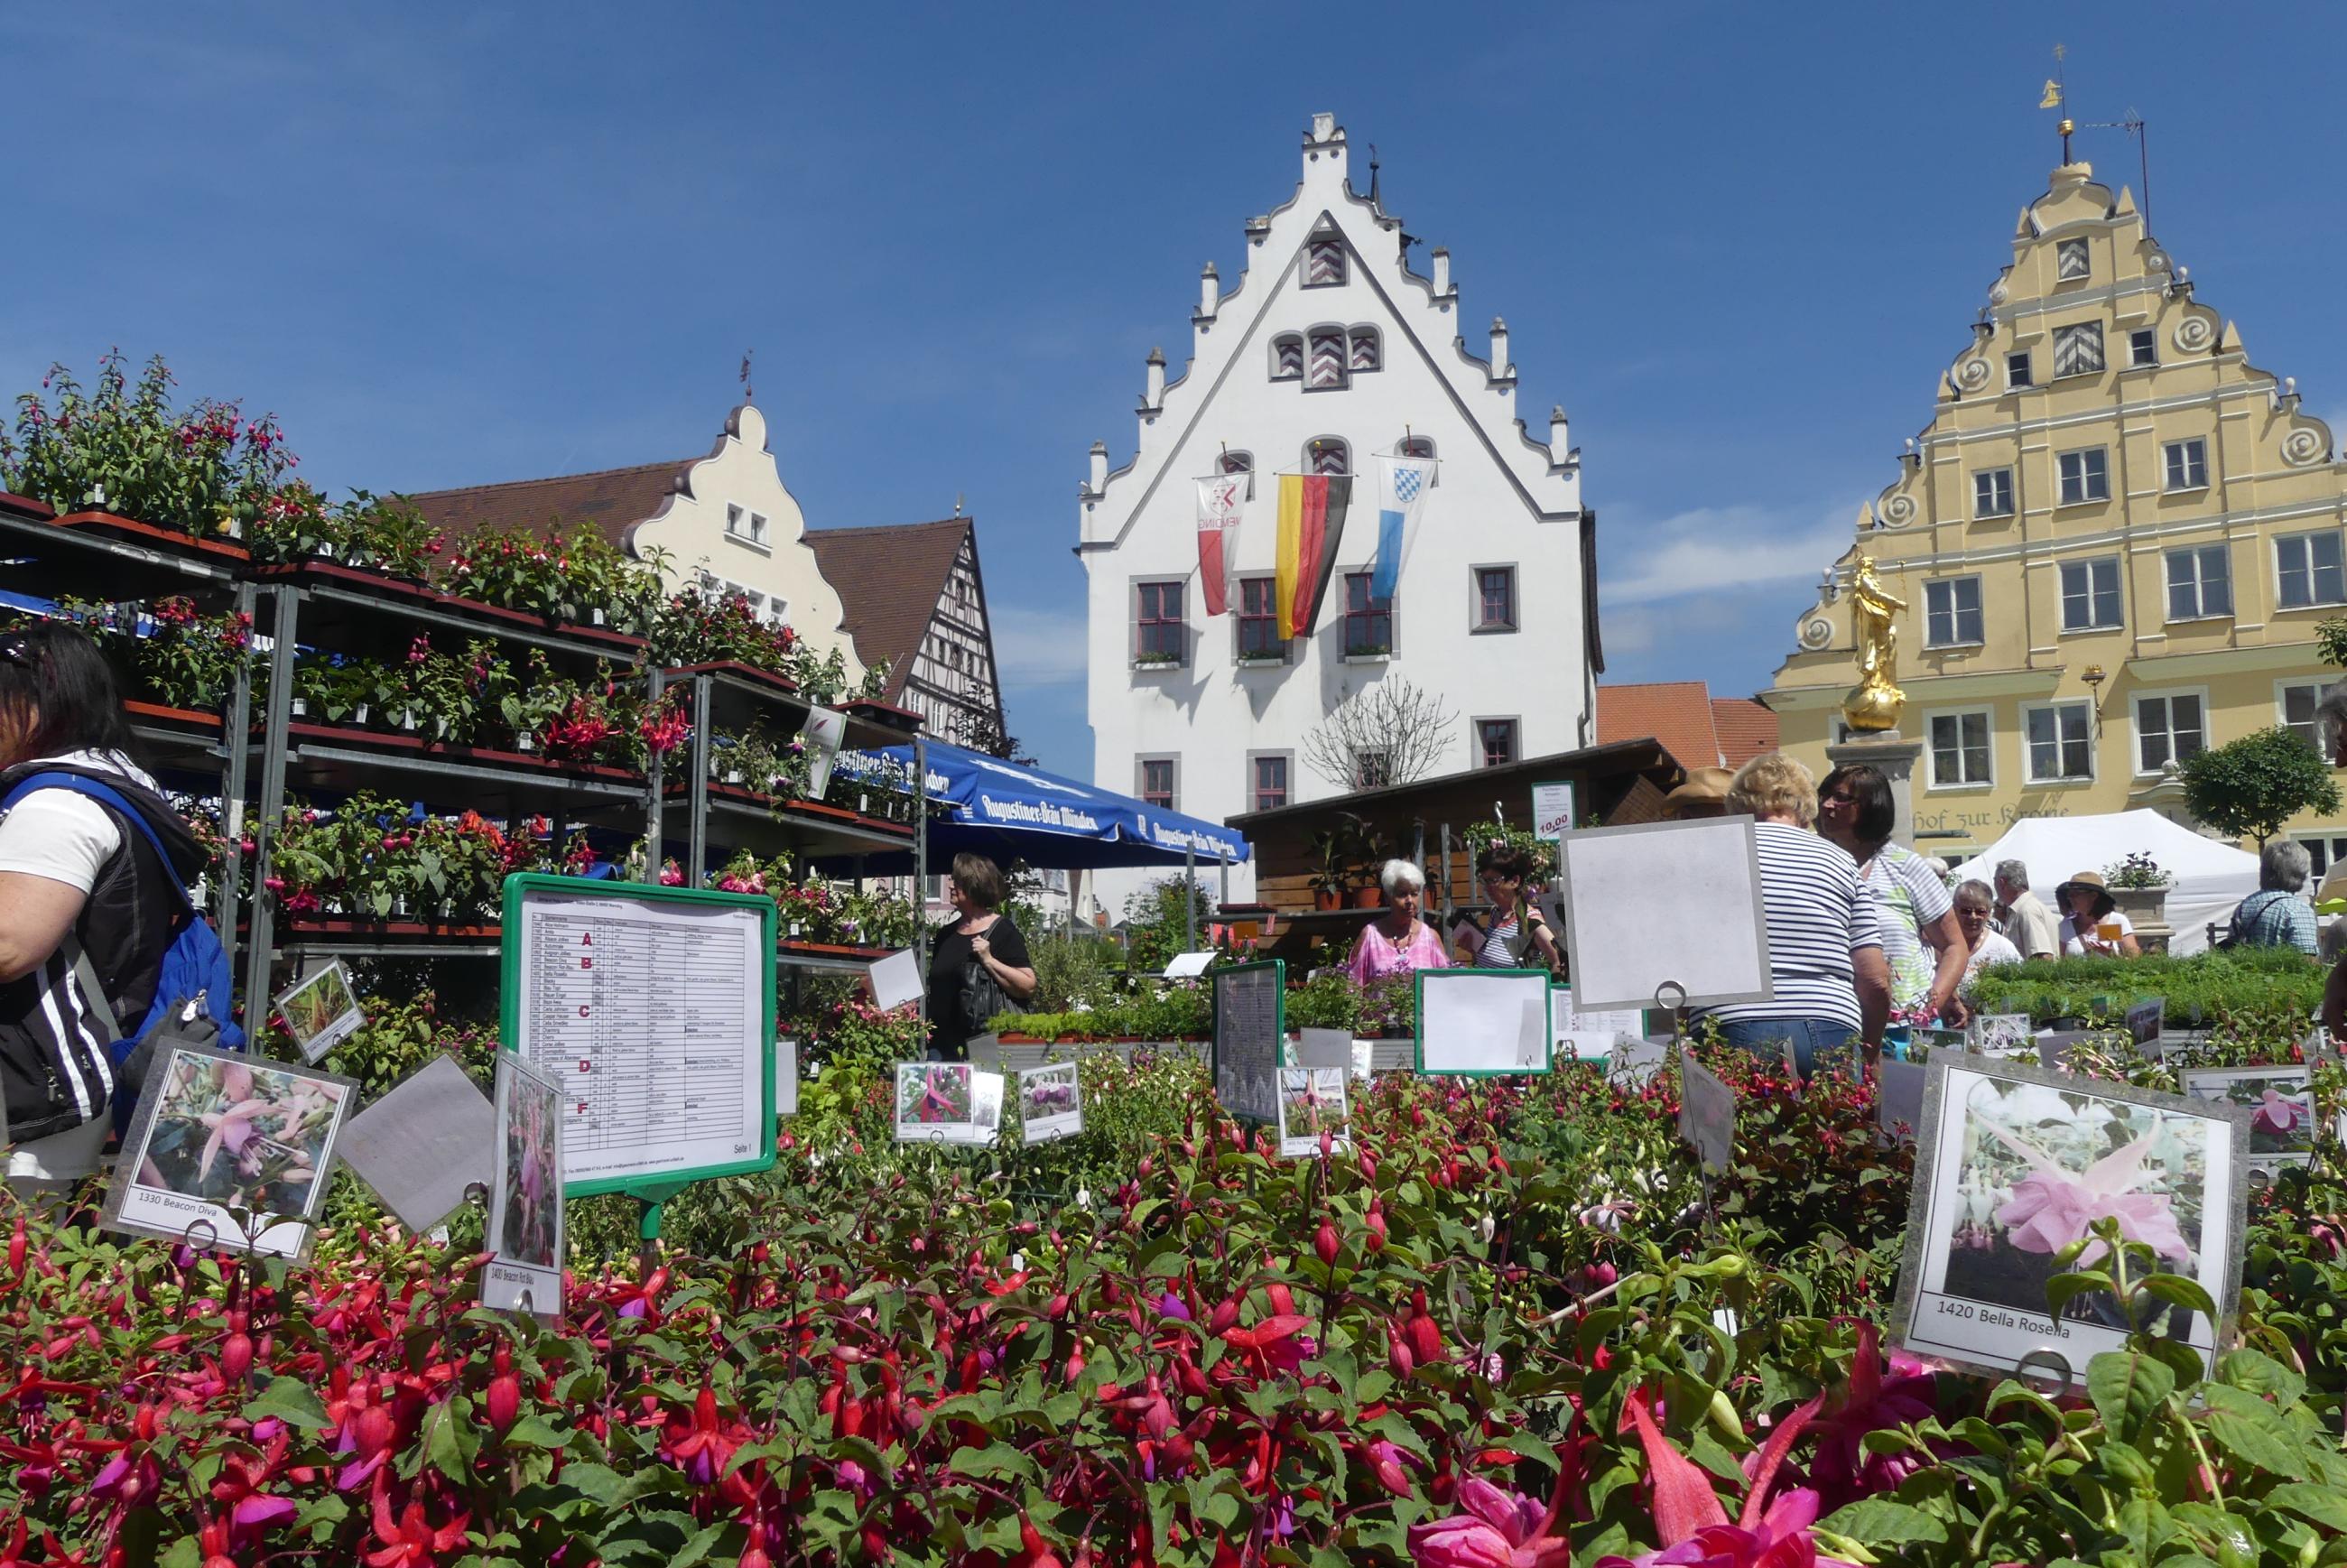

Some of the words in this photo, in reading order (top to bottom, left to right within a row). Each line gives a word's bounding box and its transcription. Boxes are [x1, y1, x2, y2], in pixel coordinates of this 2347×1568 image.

[1061, 806, 1099, 830] München
[1540, 814, 1568, 833] 10,00
[1956, 811, 1991, 830] zur
[1997, 803, 2070, 828] Krone
[582, 932, 592, 946] A
[581, 957, 592, 969] B
[579, 1005, 590, 1017] C
[579, 1060, 590, 1072] D
[578, 1103, 589, 1114] F
[734, 1144, 747, 1154] Seite
[138, 1192, 161, 1204] 1330
[163, 1198, 196, 1211] Beacon
[198, 1204, 218, 1217] Diva
[1936, 1300, 1974, 1319] 1420
[1980, 1309, 2014, 1329] Bella
